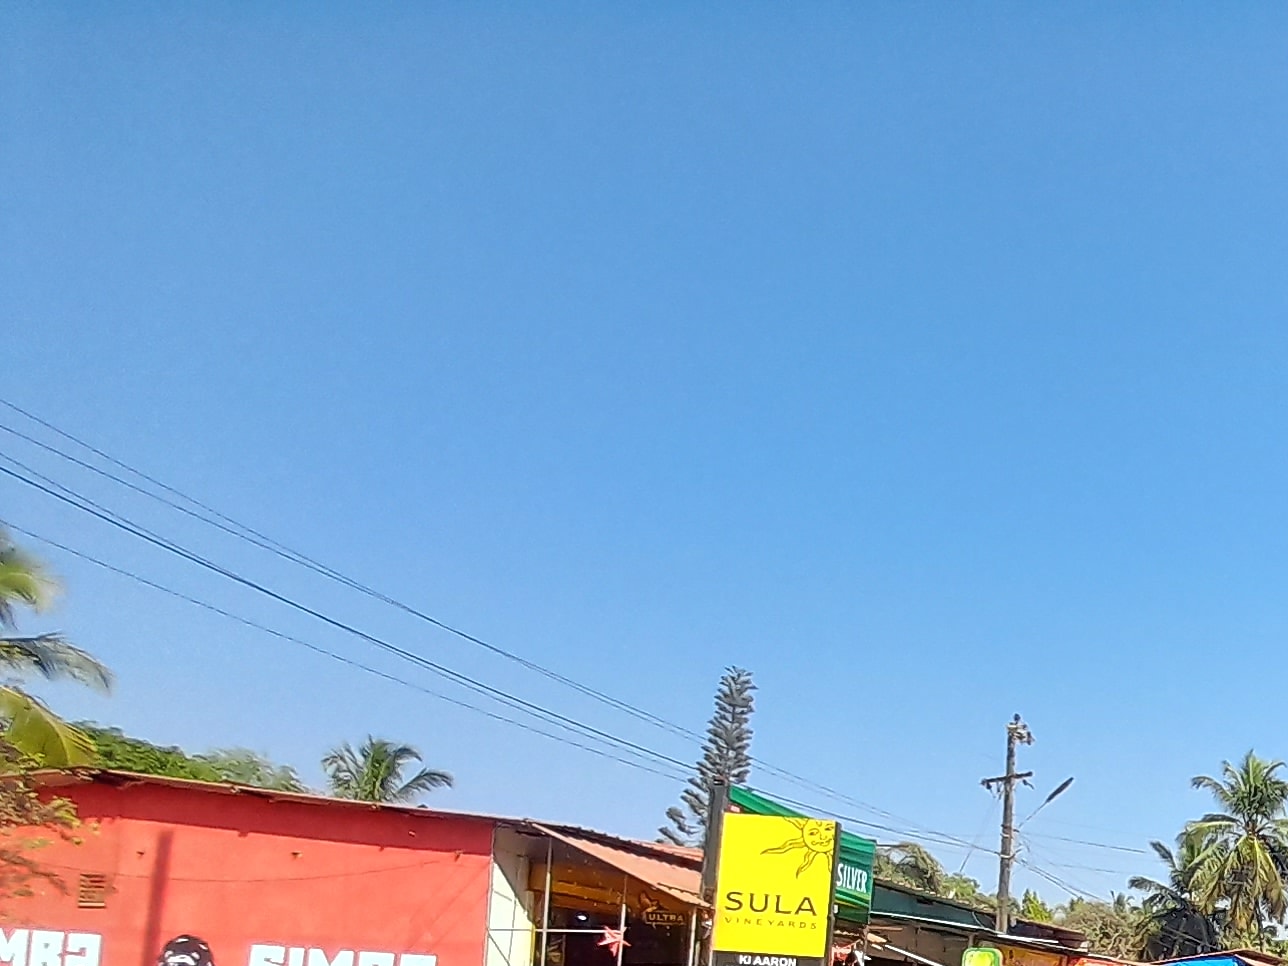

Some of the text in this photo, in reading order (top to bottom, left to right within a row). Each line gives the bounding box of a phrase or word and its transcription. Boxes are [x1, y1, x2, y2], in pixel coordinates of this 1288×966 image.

[836, 863, 868, 893] SILVER
[724, 891, 818, 917] SULA
[648, 912, 684, 922] ULTRA
[724, 916, 818, 930] VINEYARDS
